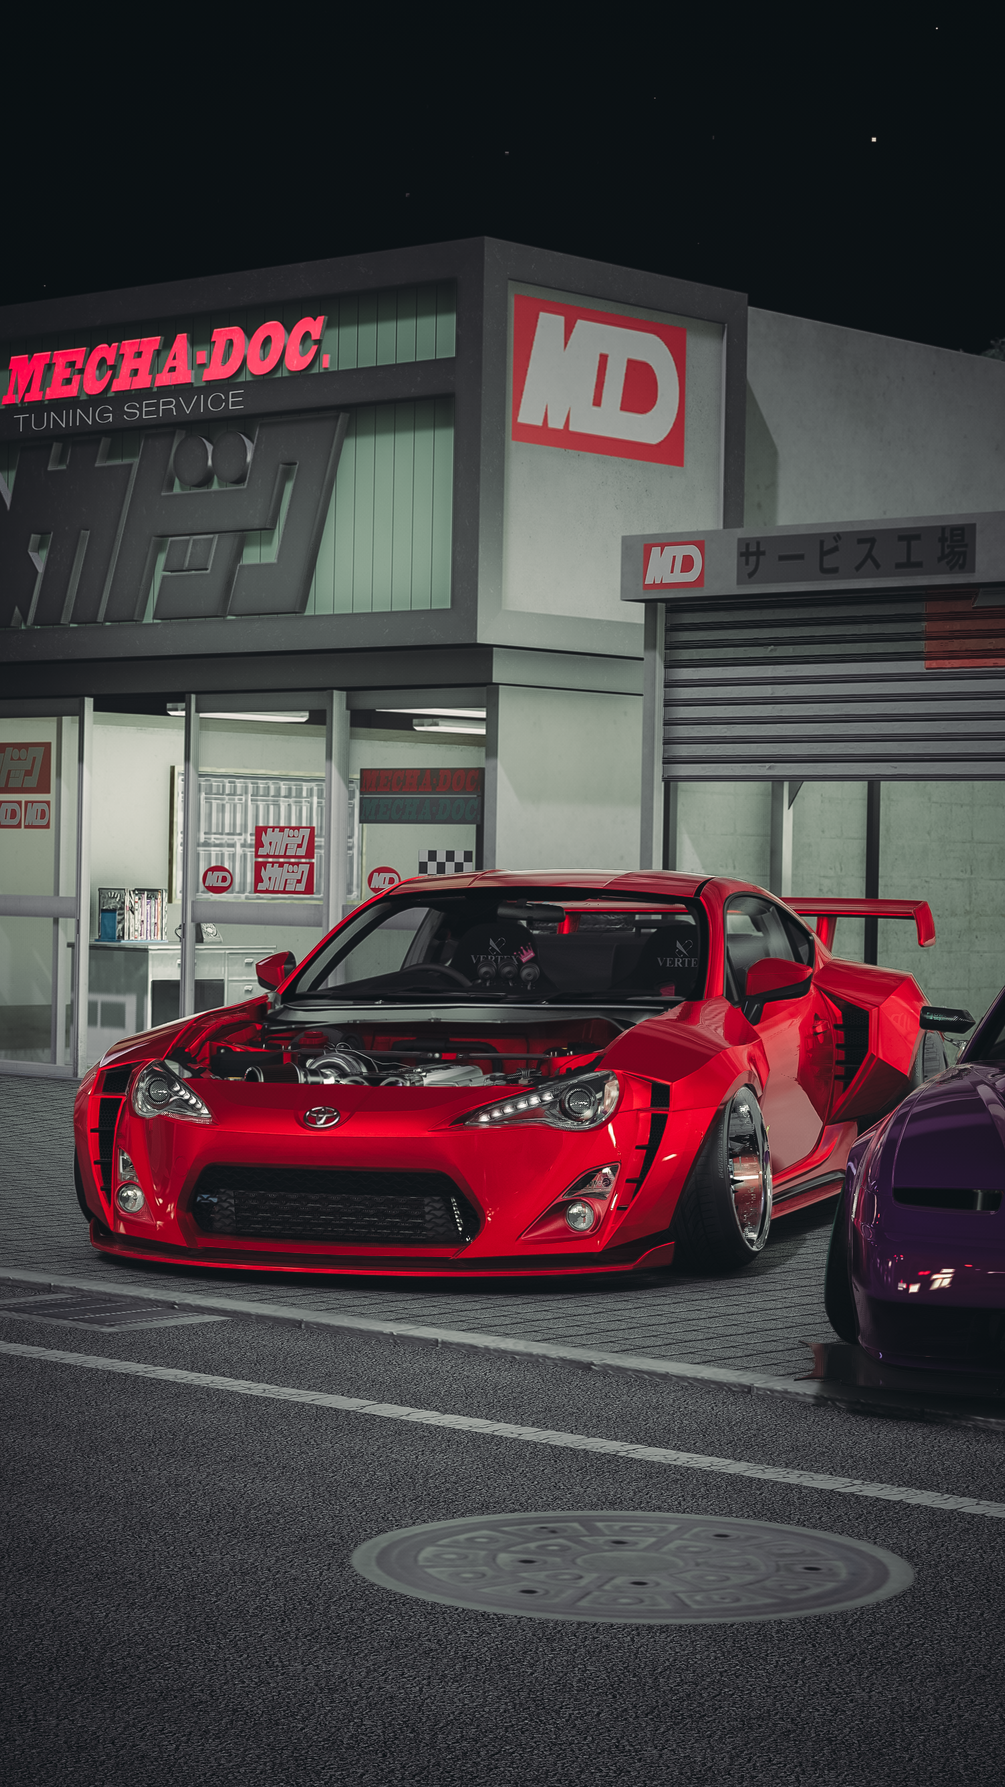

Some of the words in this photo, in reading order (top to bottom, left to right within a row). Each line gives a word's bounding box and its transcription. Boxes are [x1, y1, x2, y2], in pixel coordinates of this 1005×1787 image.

[14, 405, 113, 432] TUNING
[124, 390, 245, 420] SERVICE
[739, 526, 969, 579] サービス工場
